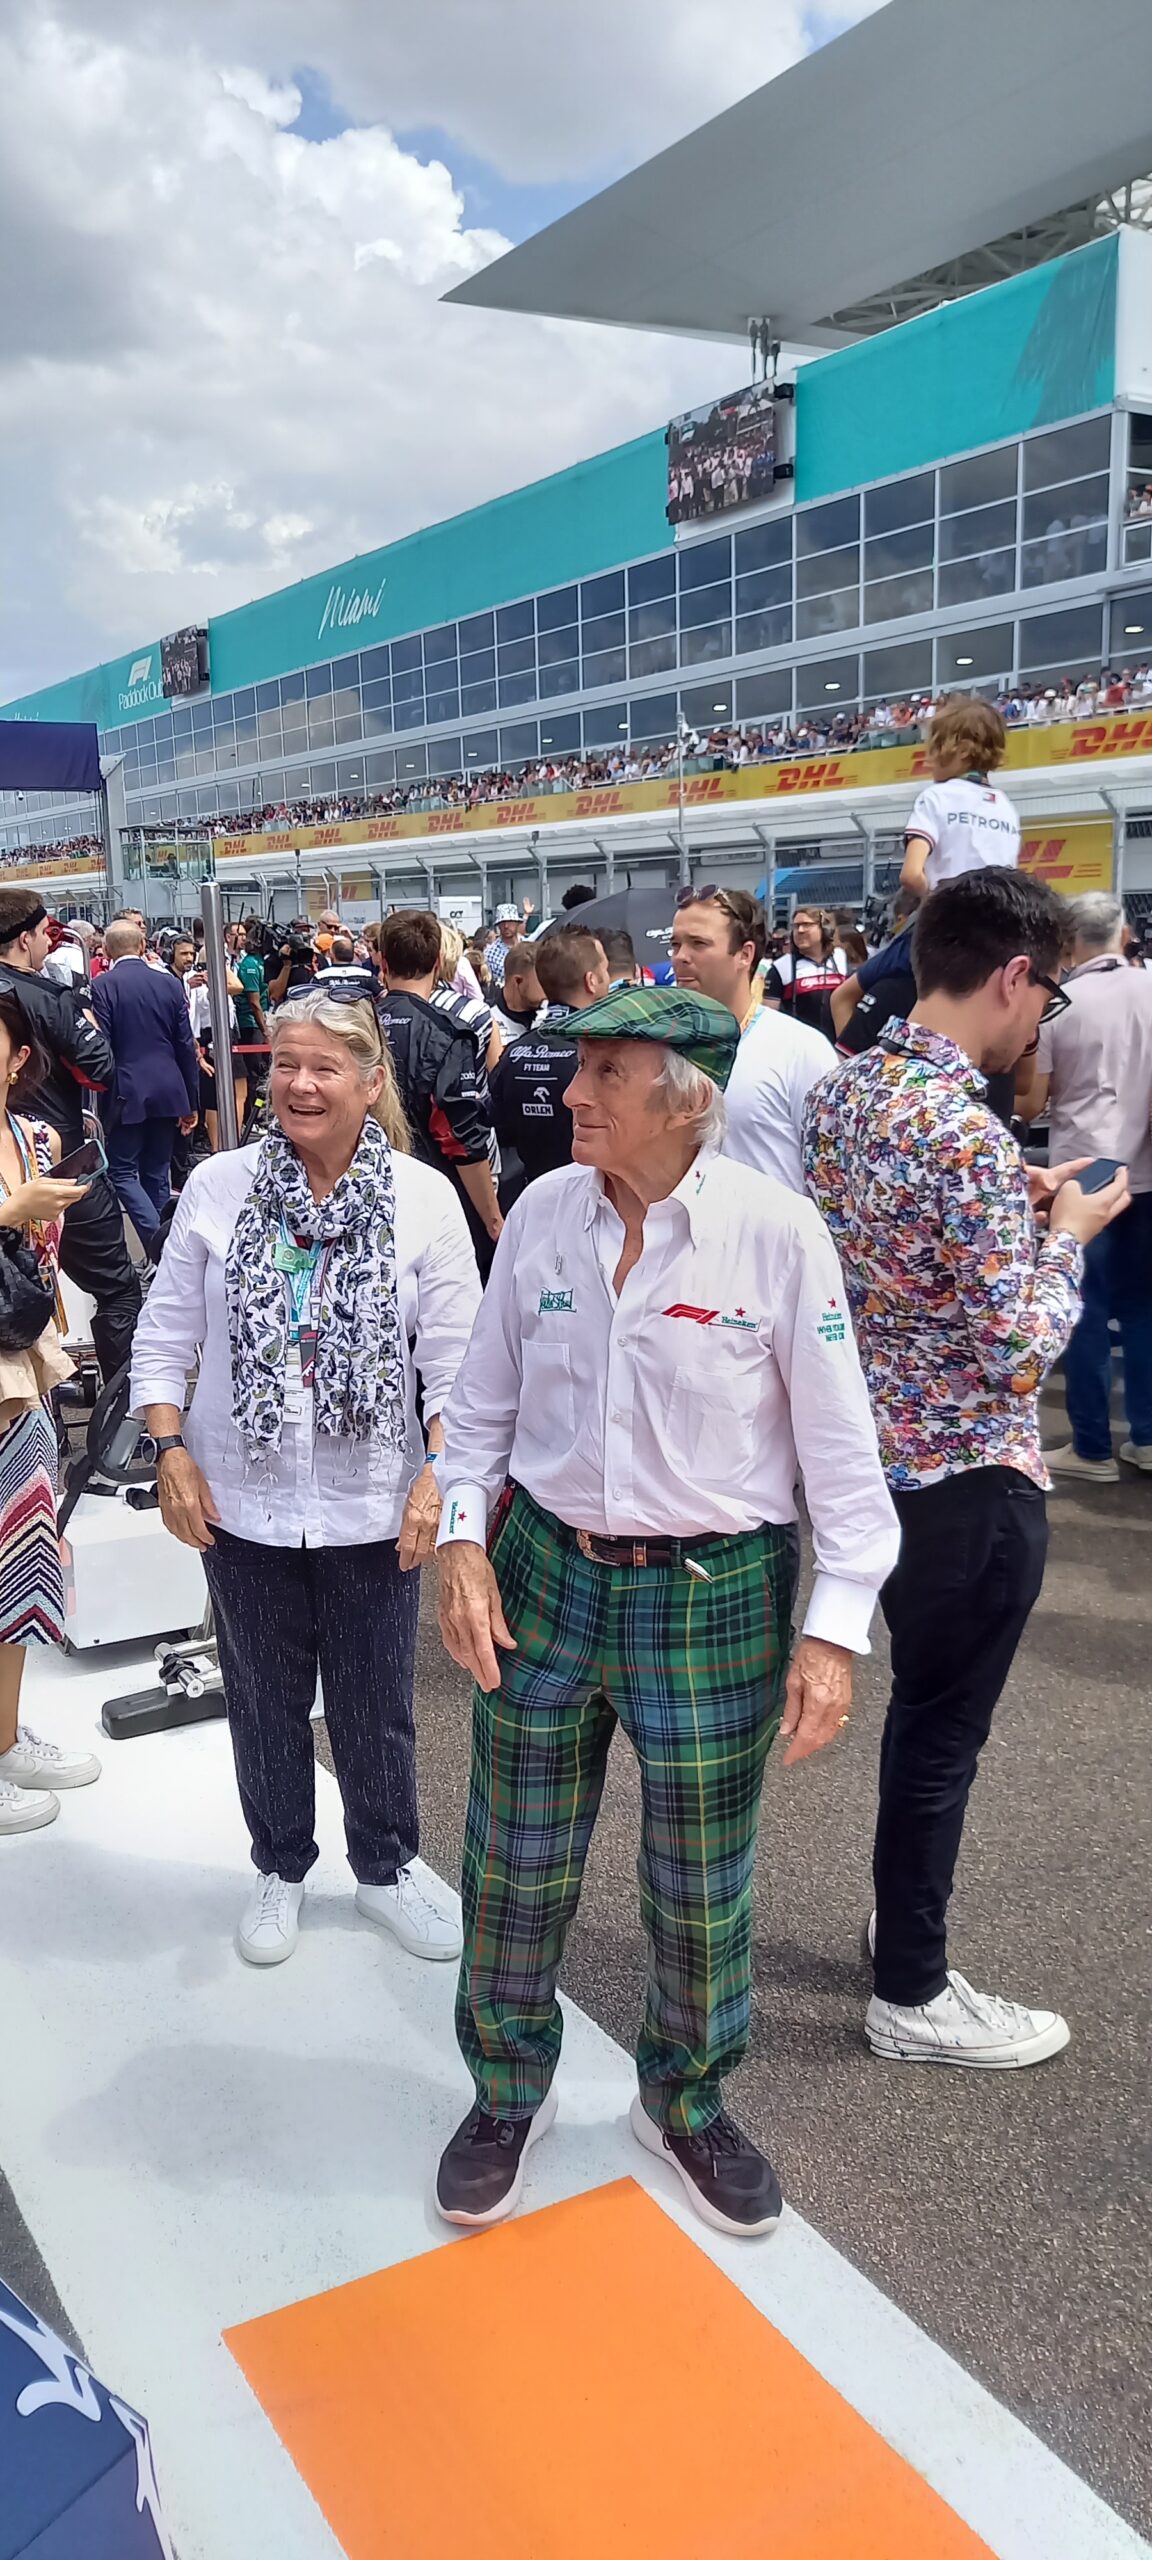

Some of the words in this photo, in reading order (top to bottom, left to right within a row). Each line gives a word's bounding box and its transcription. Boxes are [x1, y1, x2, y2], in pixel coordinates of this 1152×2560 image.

[317, 578, 386, 640] Miami
[118, 684, 149, 711] Paddock
[777, 762, 844, 792] DHL
[667, 778, 724, 805] DHL
[575, 791, 624, 816] DHL
[428, 813, 464, 833] DHL
[496, 803, 538, 824] DHL
[313, 828, 342, 845] DHL
[367, 821, 399, 839] DHL
[223, 840, 247, 855] DHL
[265, 834, 292, 850] DHL
[509, 1045, 532, 1063] Alfa
[532, 1045, 576, 1058] Romeo
[532, 1063, 550, 1071] TEAM
[524, 1105, 552, 1115] ORLEN
[660, 1303, 720, 1325] F1
[721, 1316, 757, 1329] Heineken
